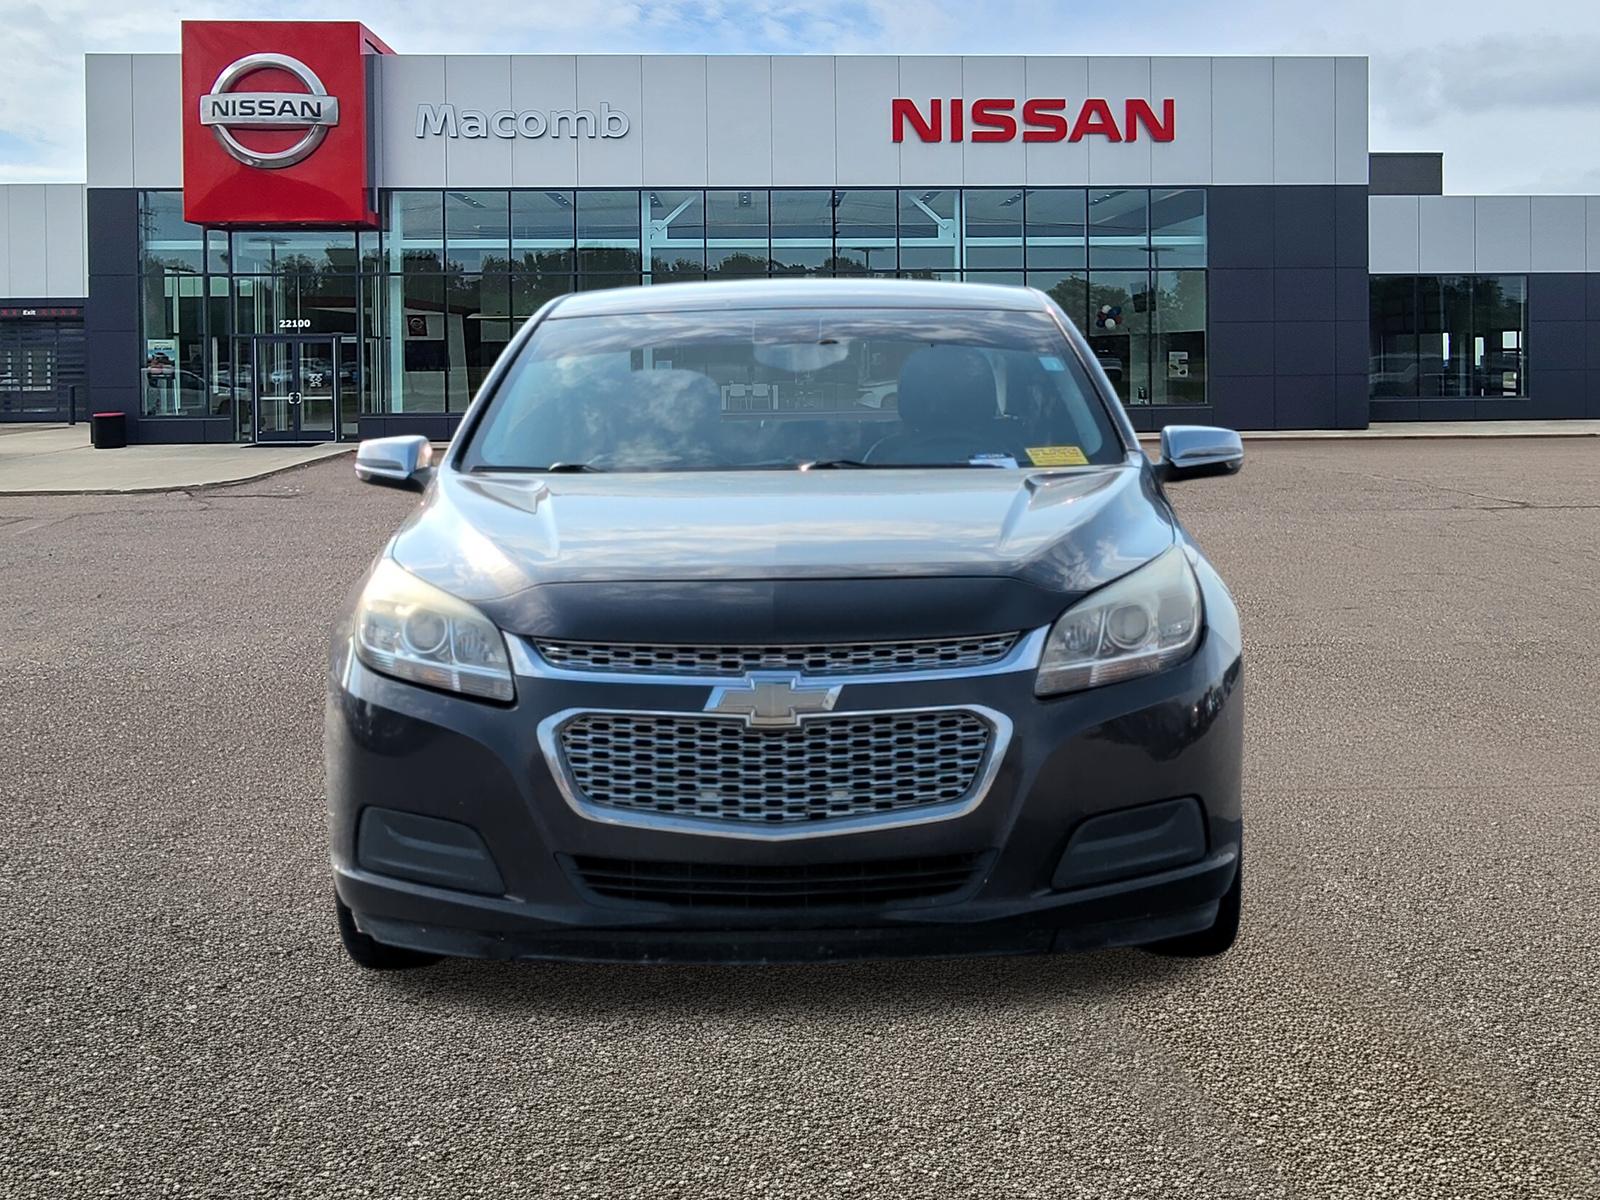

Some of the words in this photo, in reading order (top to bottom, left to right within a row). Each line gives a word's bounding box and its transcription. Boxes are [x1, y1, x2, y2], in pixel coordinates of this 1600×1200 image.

[212, 100, 321, 117] NISSAN
[415, 102, 630, 139] Macomb
[891, 98, 1175, 143] NISSAN
[279, 319, 311, 328] 22100
